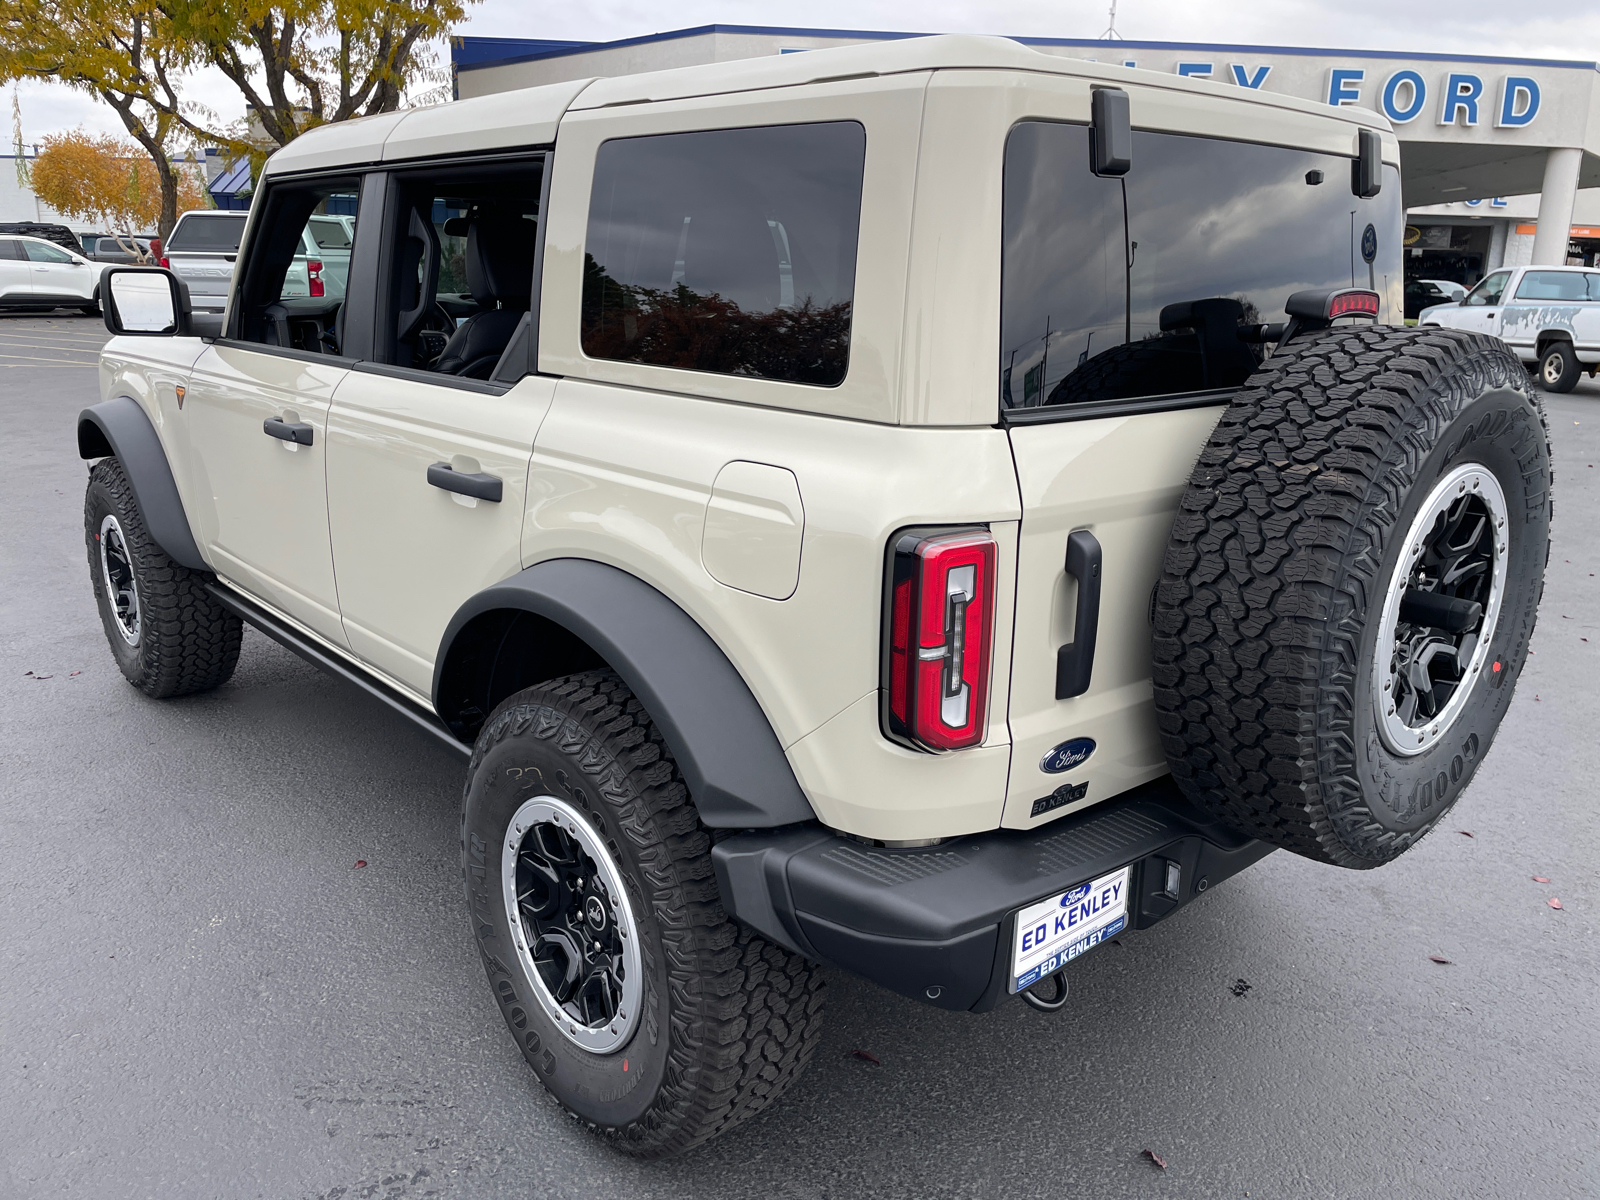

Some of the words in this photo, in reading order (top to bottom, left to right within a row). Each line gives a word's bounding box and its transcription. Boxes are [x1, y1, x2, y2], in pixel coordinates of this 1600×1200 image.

[1327, 68, 1541, 128] FORD
[1055, 746, 1086, 769] Ford
[1032, 801, 1047, 814] ED
[1049, 786, 1088, 808] KENLEY
[1022, 923, 1047, 952] ED
[1054, 881, 1122, 935] KENLEY
[1065, 886, 1088, 906] Ford
[470, 832, 558, 1076] GOODYEAR
[1040, 958, 1057, 977] ED
[1060, 930, 1104, 966] KENLEY
